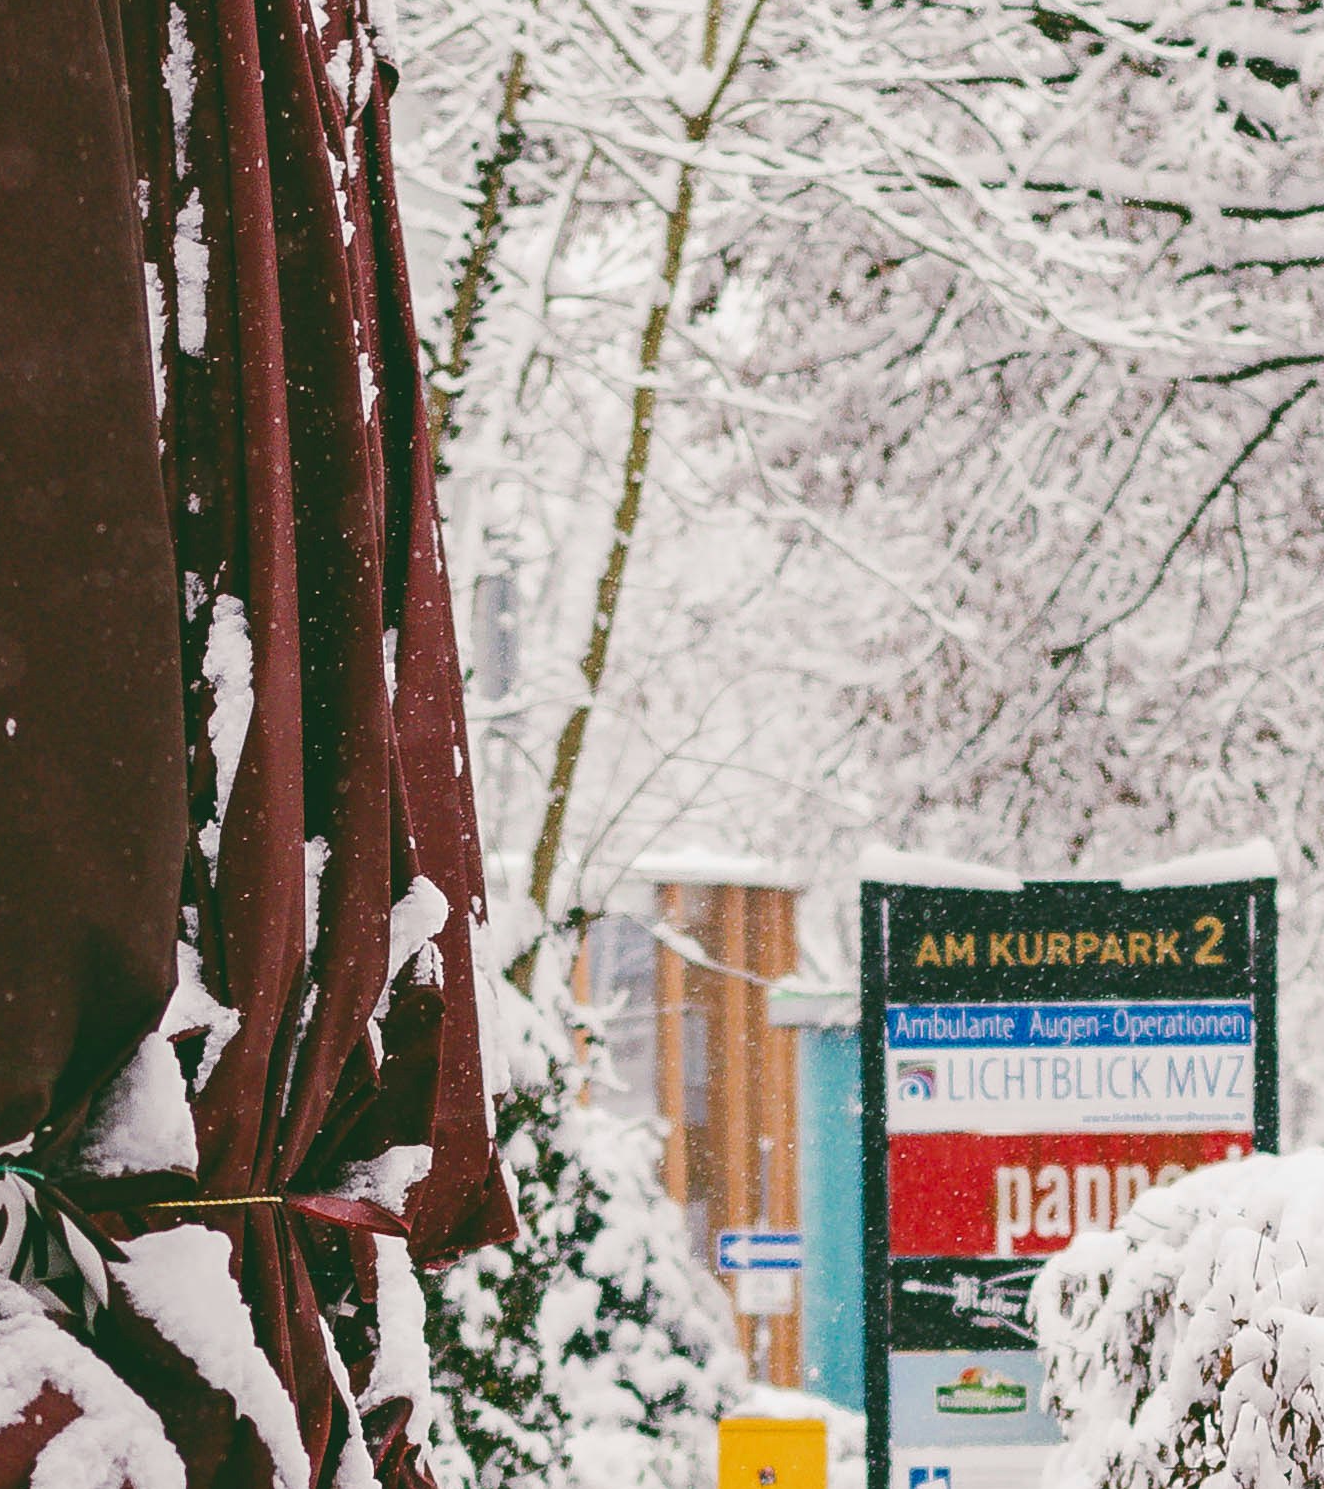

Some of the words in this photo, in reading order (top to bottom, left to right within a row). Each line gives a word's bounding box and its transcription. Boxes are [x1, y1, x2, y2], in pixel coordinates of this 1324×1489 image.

[916, 933, 976, 967] AM
[989, 932, 1180, 965] KURPARK
[1193, 915, 1225, 964] 2
[895, 1011, 1015, 1040] Ambulante
[948, 1057, 1152, 1100] LICHTBLICK
[1166, 1055, 1246, 1098] MVZ
